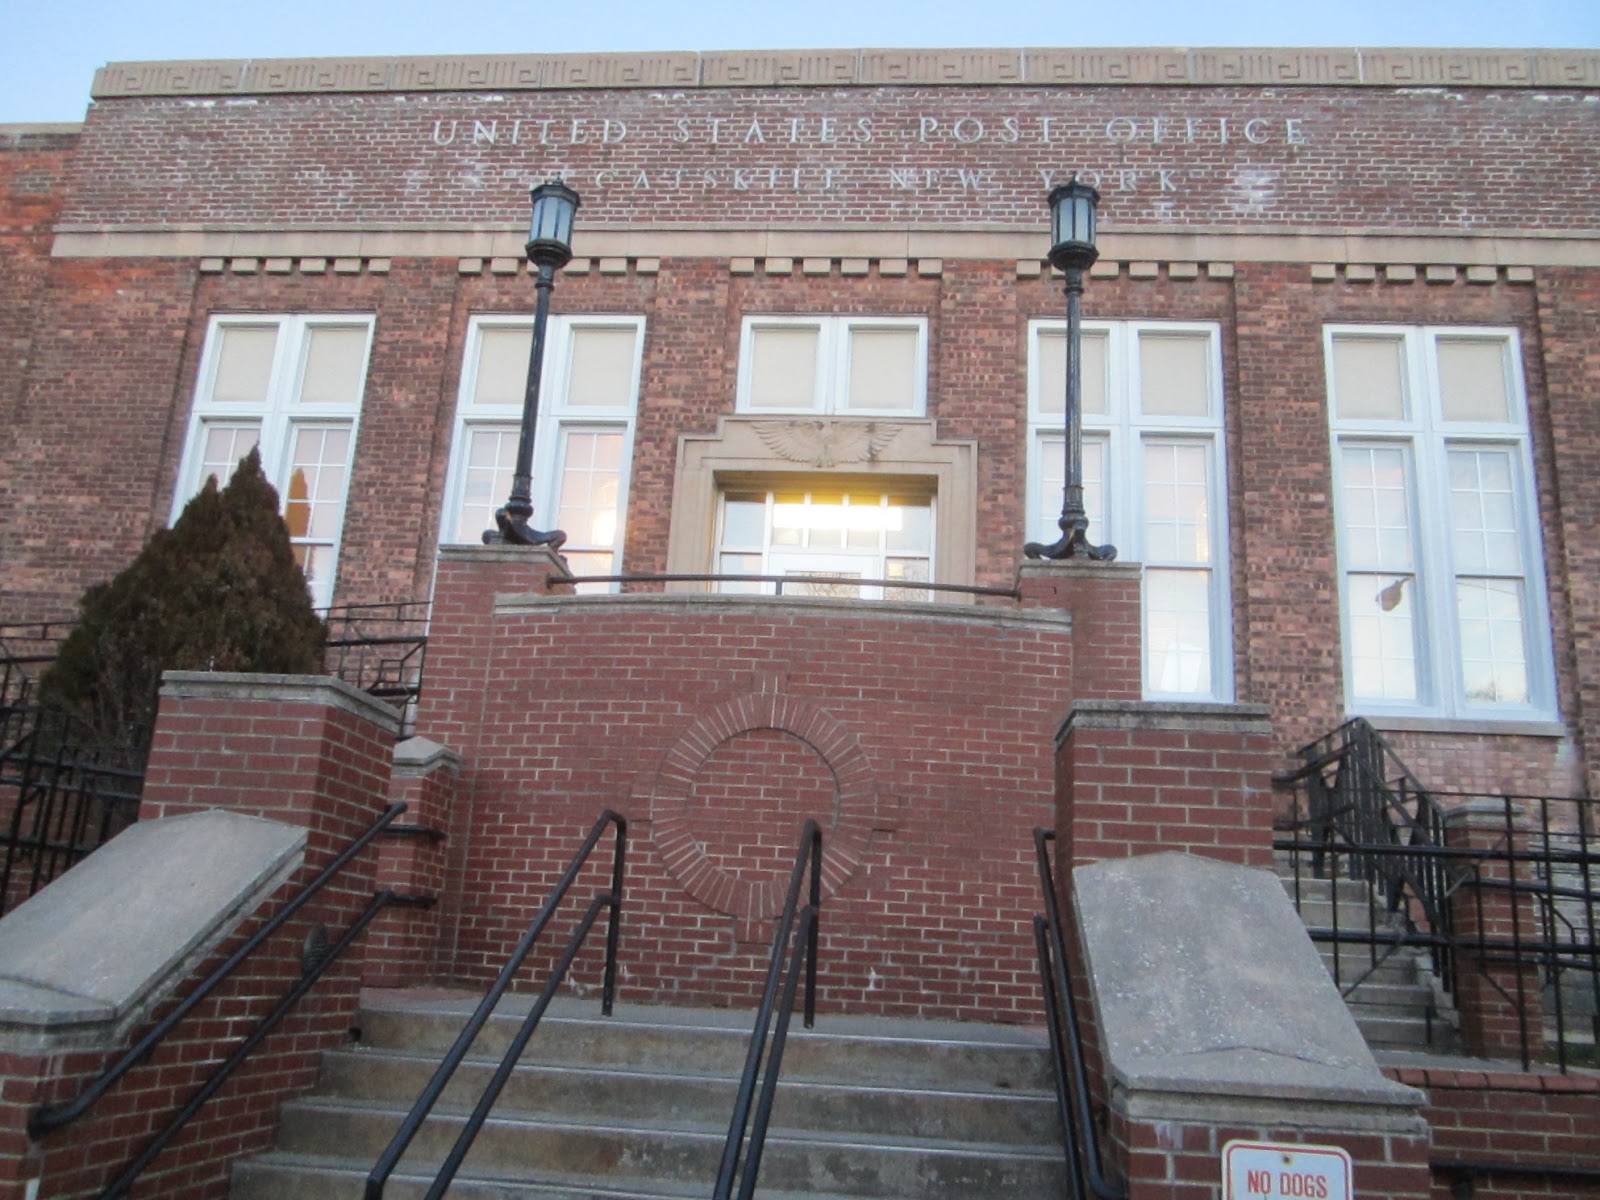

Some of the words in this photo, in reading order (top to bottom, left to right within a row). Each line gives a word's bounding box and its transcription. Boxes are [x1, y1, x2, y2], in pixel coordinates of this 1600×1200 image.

[432, 119, 628, 146] UNITED
[673, 118, 873, 144] STATES
[919, 117, 1058, 144] POST
[1106, 117, 1306, 145] OFFICE
[595, 169, 839, 190] CATSKILL
[889, 169, 984, 190] NEW
[1039, 169, 1178, 191] YORK
[1248, 1170, 1271, 1194] NO
[1280, 1172, 1328, 1198] DOGS
